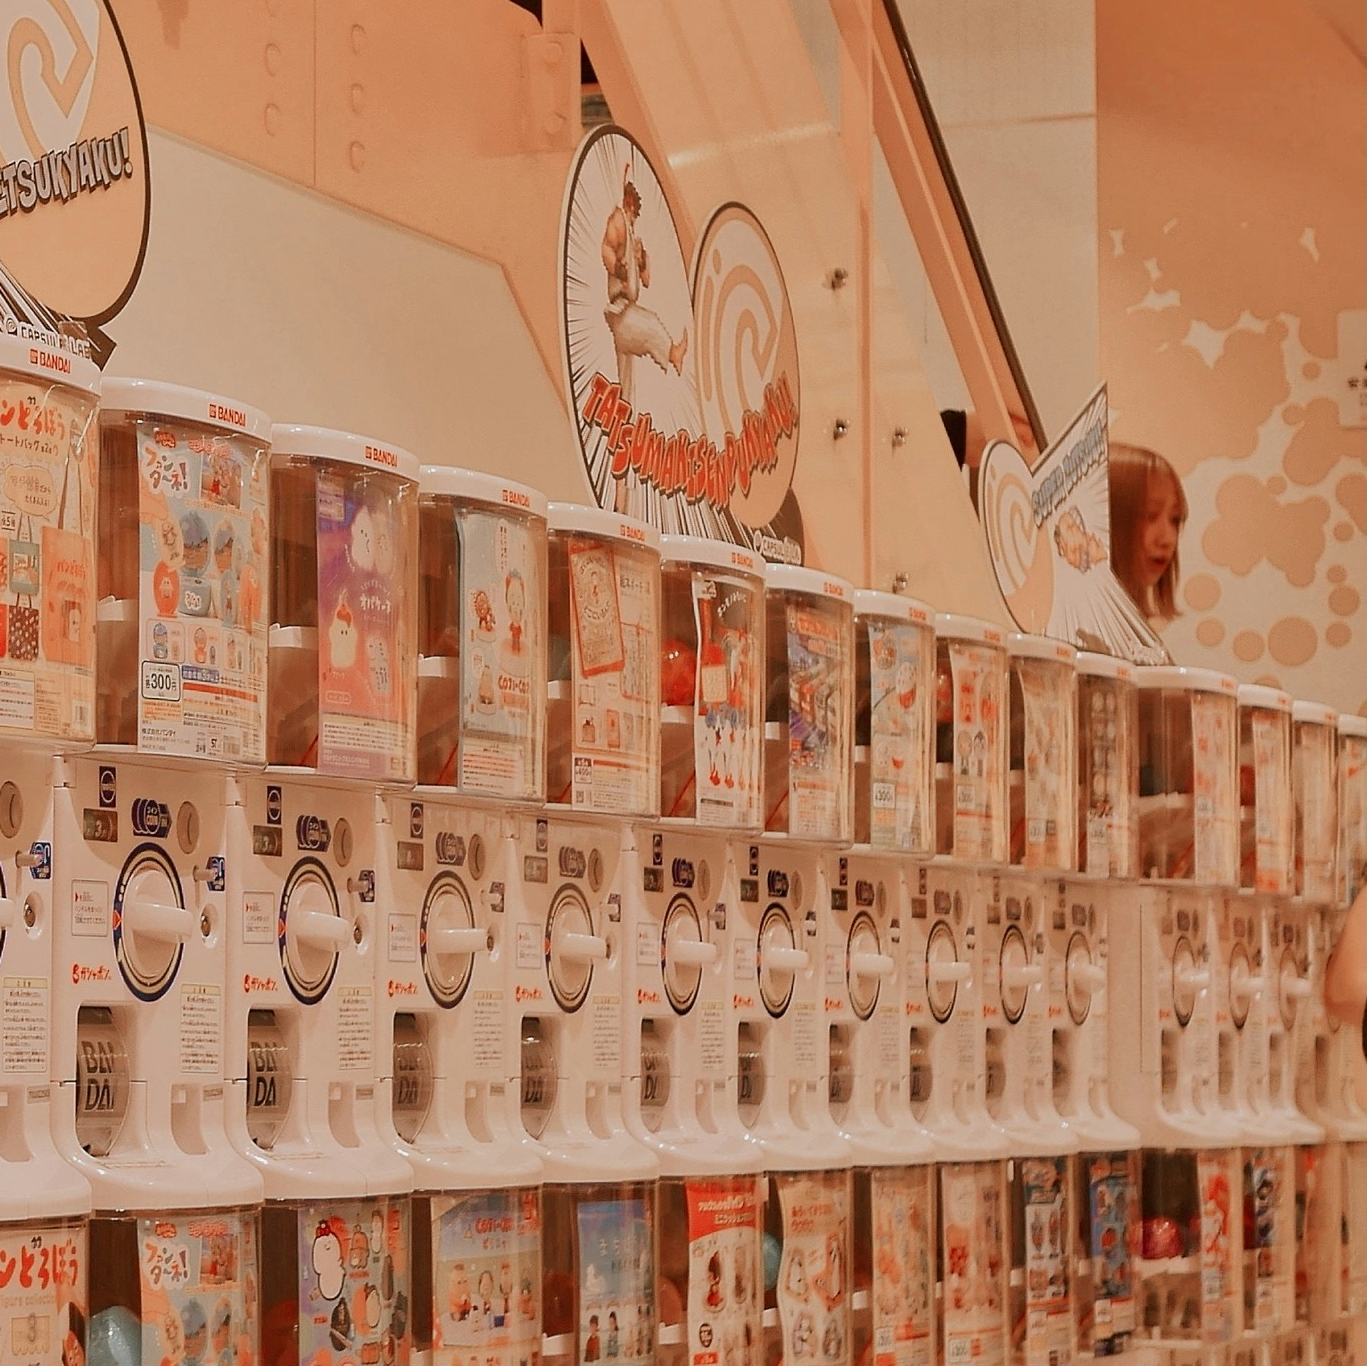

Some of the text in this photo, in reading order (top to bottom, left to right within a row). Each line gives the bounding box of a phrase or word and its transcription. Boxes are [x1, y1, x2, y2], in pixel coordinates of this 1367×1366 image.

[39, 357, 71, 375] BANDAI
[217, 405, 246, 428] BANDAI
[372, 447, 398, 468] BANDAI
